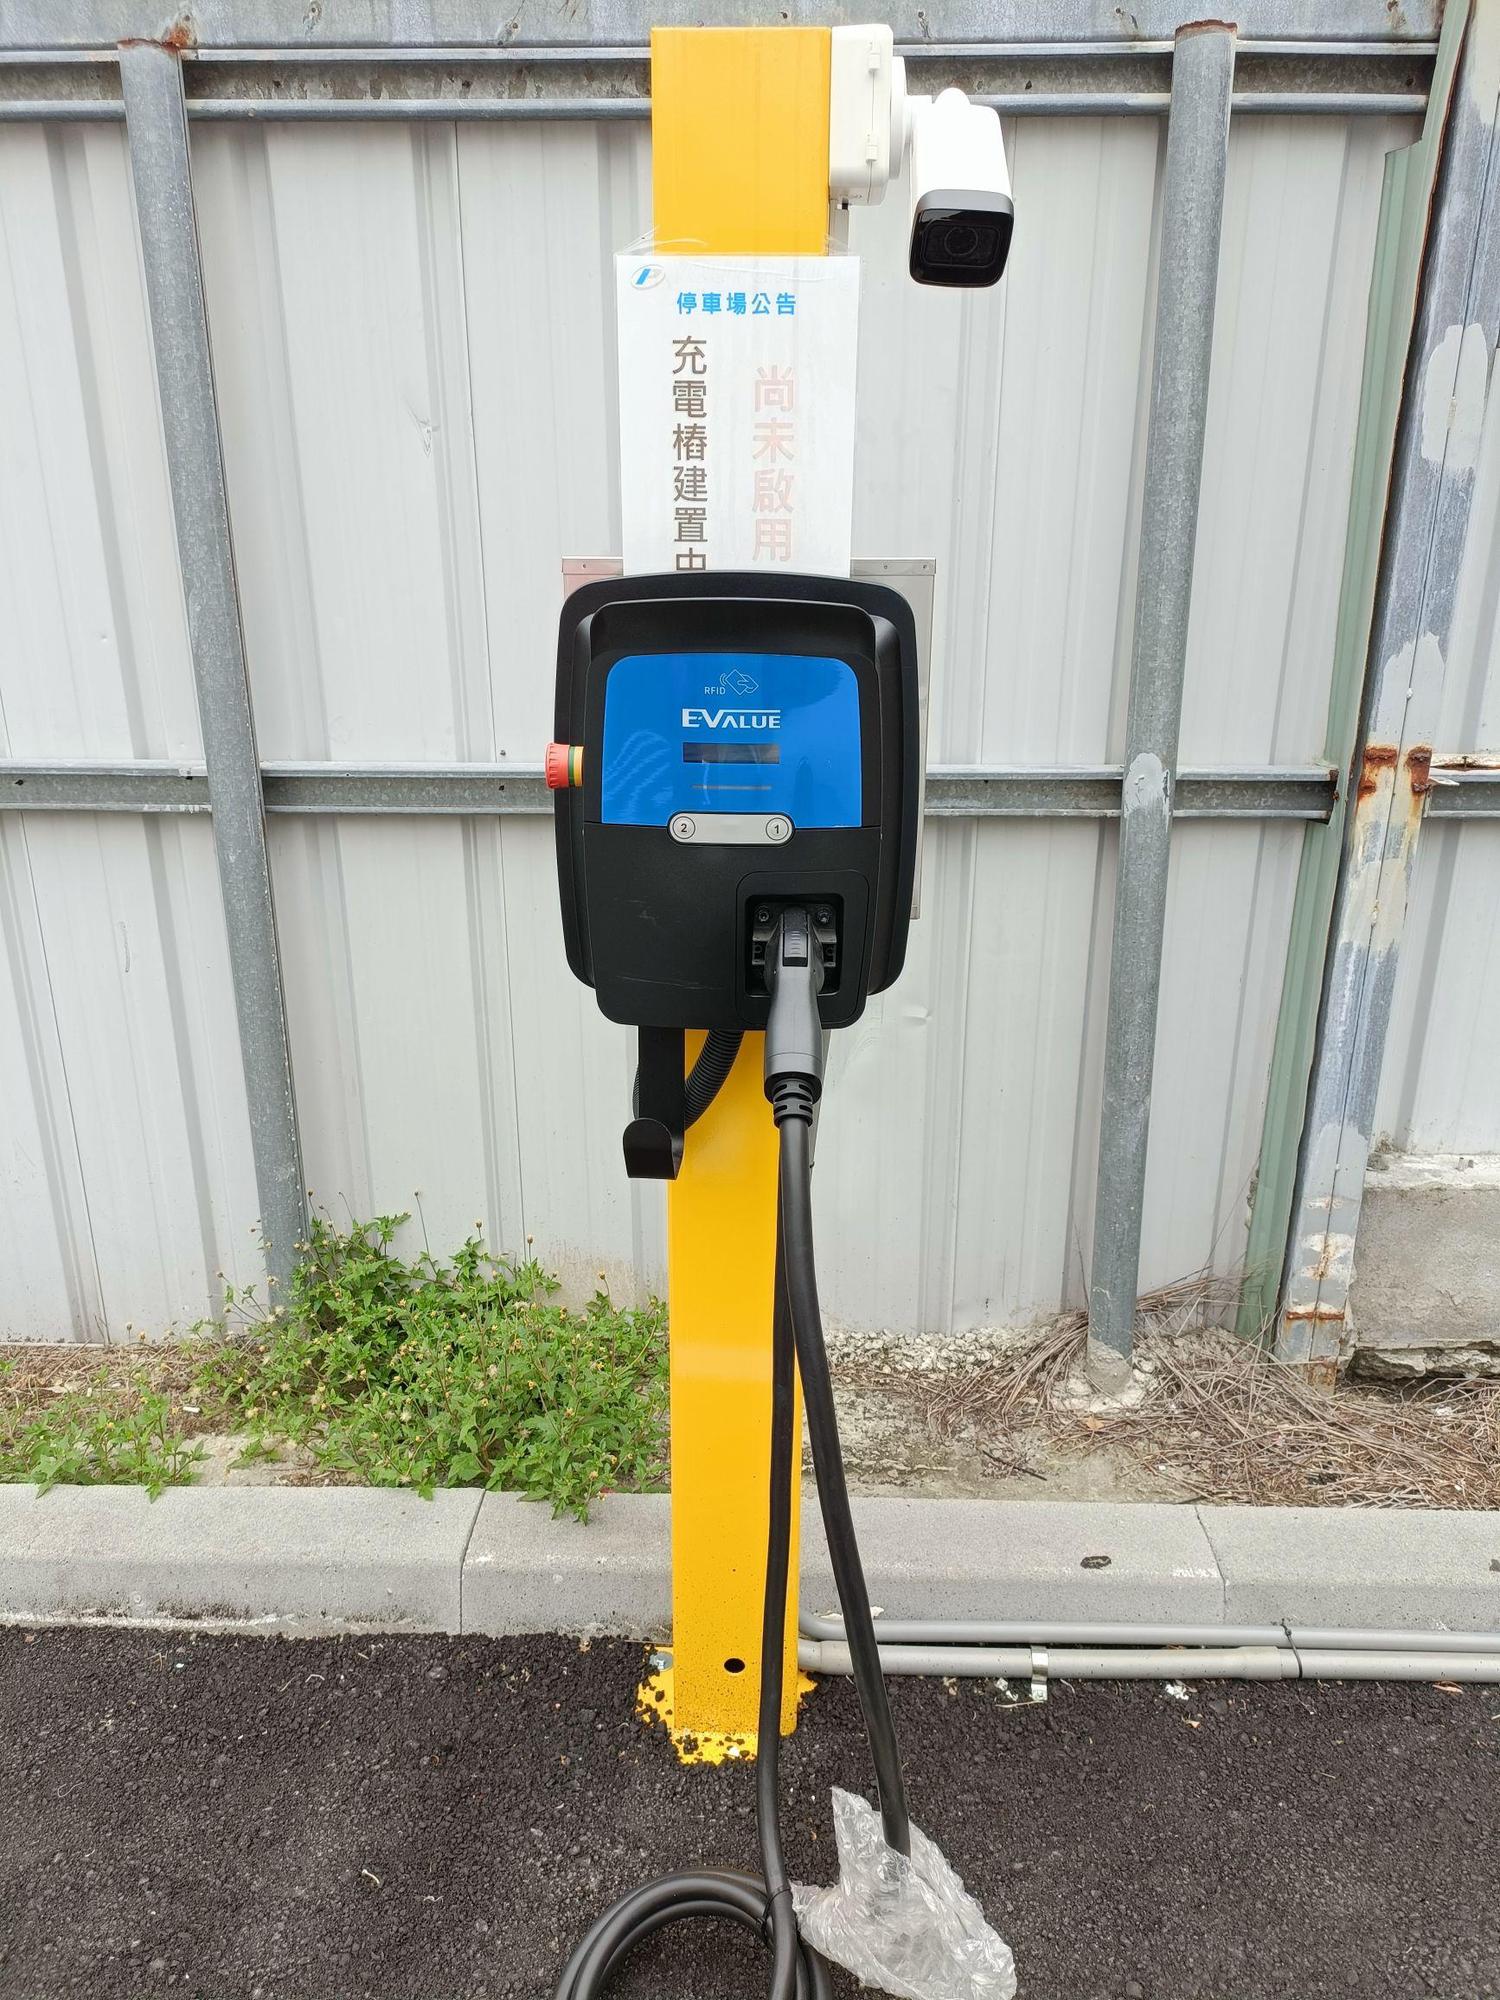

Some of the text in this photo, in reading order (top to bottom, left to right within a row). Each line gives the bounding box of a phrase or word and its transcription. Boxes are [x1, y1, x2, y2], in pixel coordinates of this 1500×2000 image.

[676, 292, 797, 315] 停車場公告
[752, 364, 795, 562] 尚未啟用
[704, 686, 726, 695] RFID
